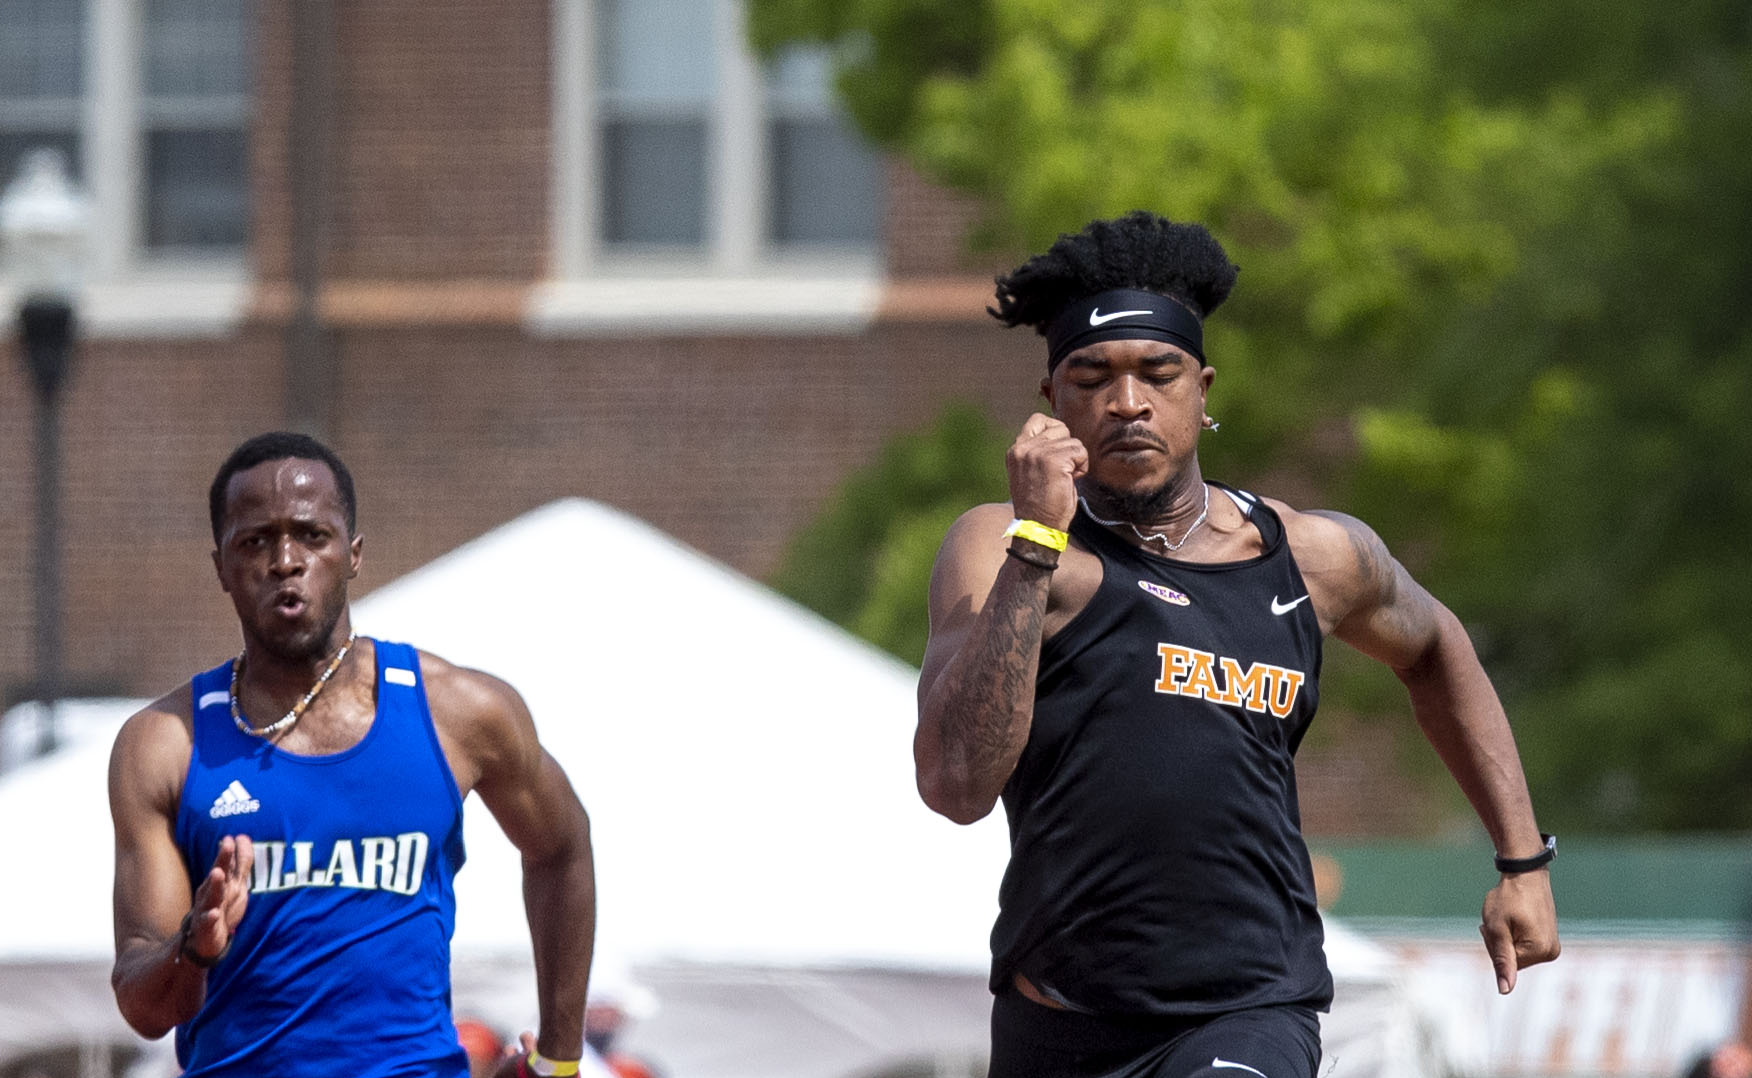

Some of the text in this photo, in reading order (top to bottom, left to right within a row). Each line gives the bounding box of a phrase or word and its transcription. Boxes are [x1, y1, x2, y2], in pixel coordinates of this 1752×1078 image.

[1155, 642, 1304, 718] FAMU
[209, 799, 260, 819] adidas
[246, 832, 429, 896] ILLARD
